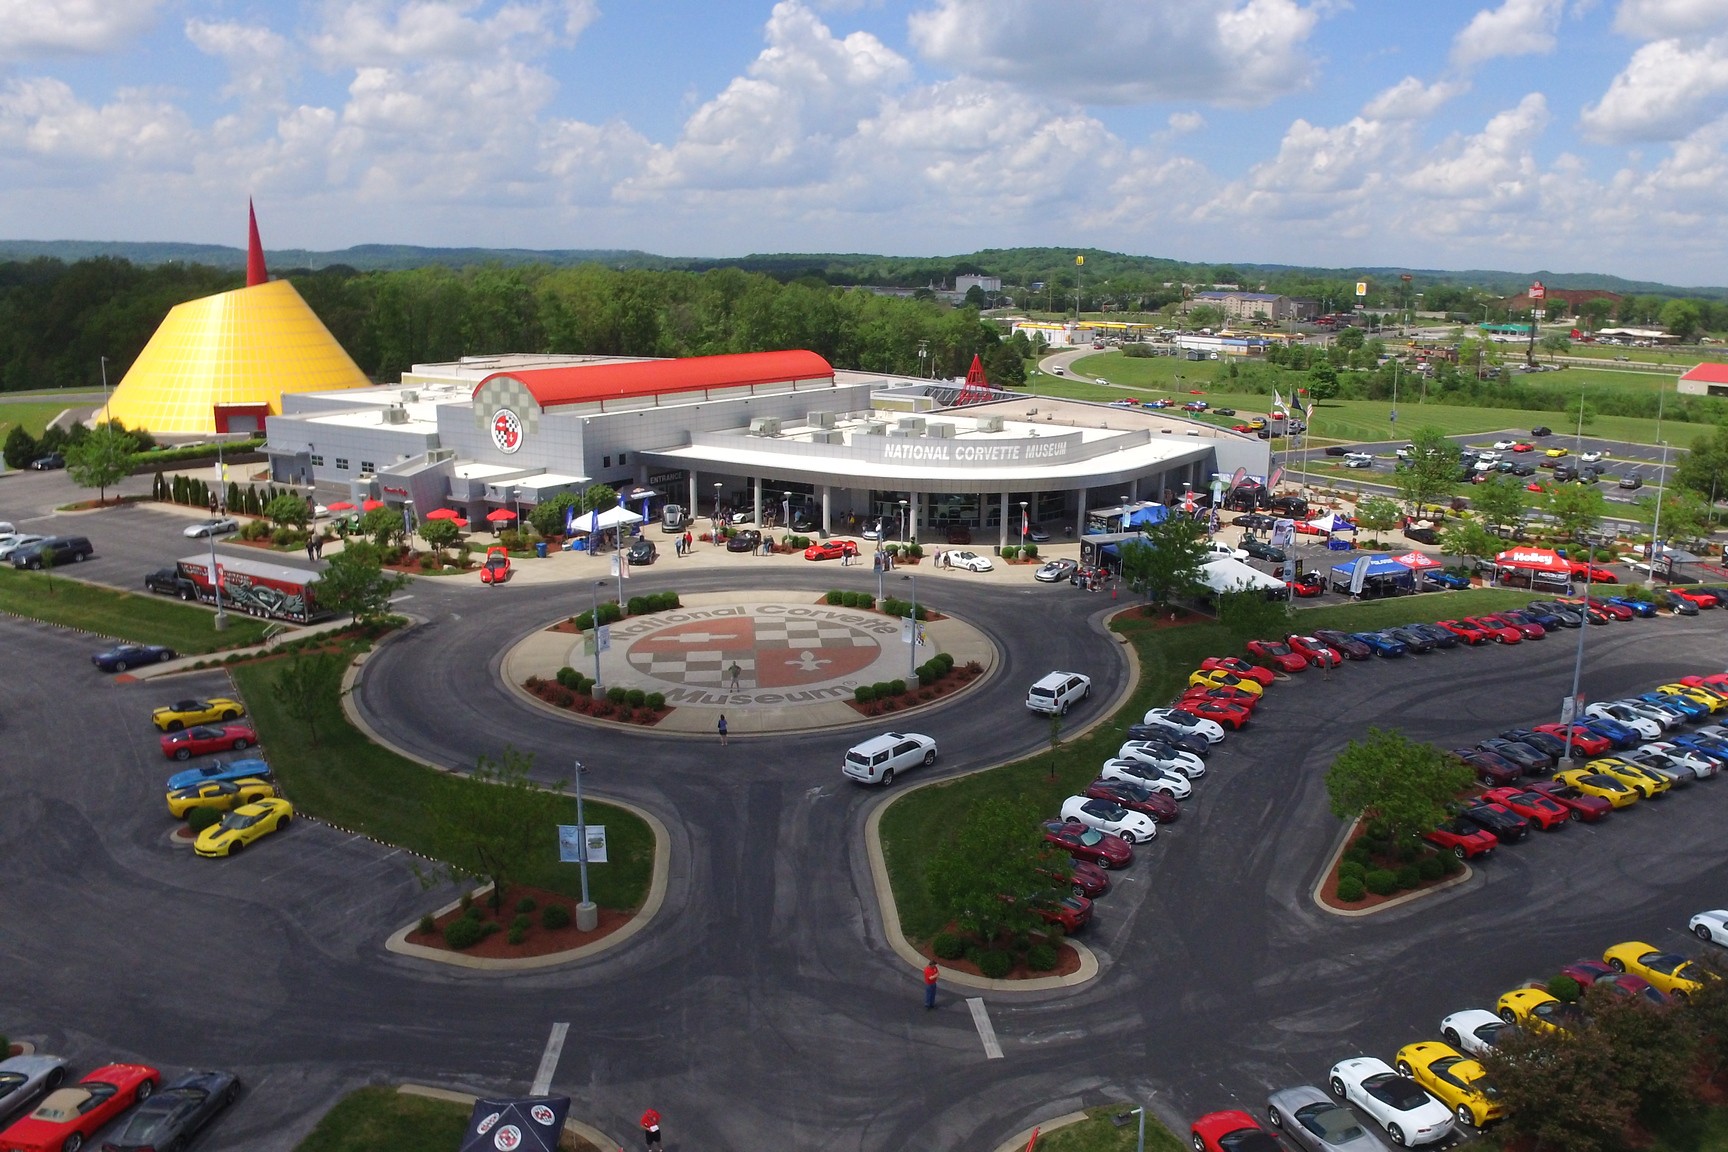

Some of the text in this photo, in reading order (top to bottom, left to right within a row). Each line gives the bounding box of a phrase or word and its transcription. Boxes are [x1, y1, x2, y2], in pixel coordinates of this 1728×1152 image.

[884, 441, 1067, 460] NATIONAL CORVETTE MUSEUM
[1513, 552, 1553, 565] Holley
[609, 605, 898, 641] National Corvette
